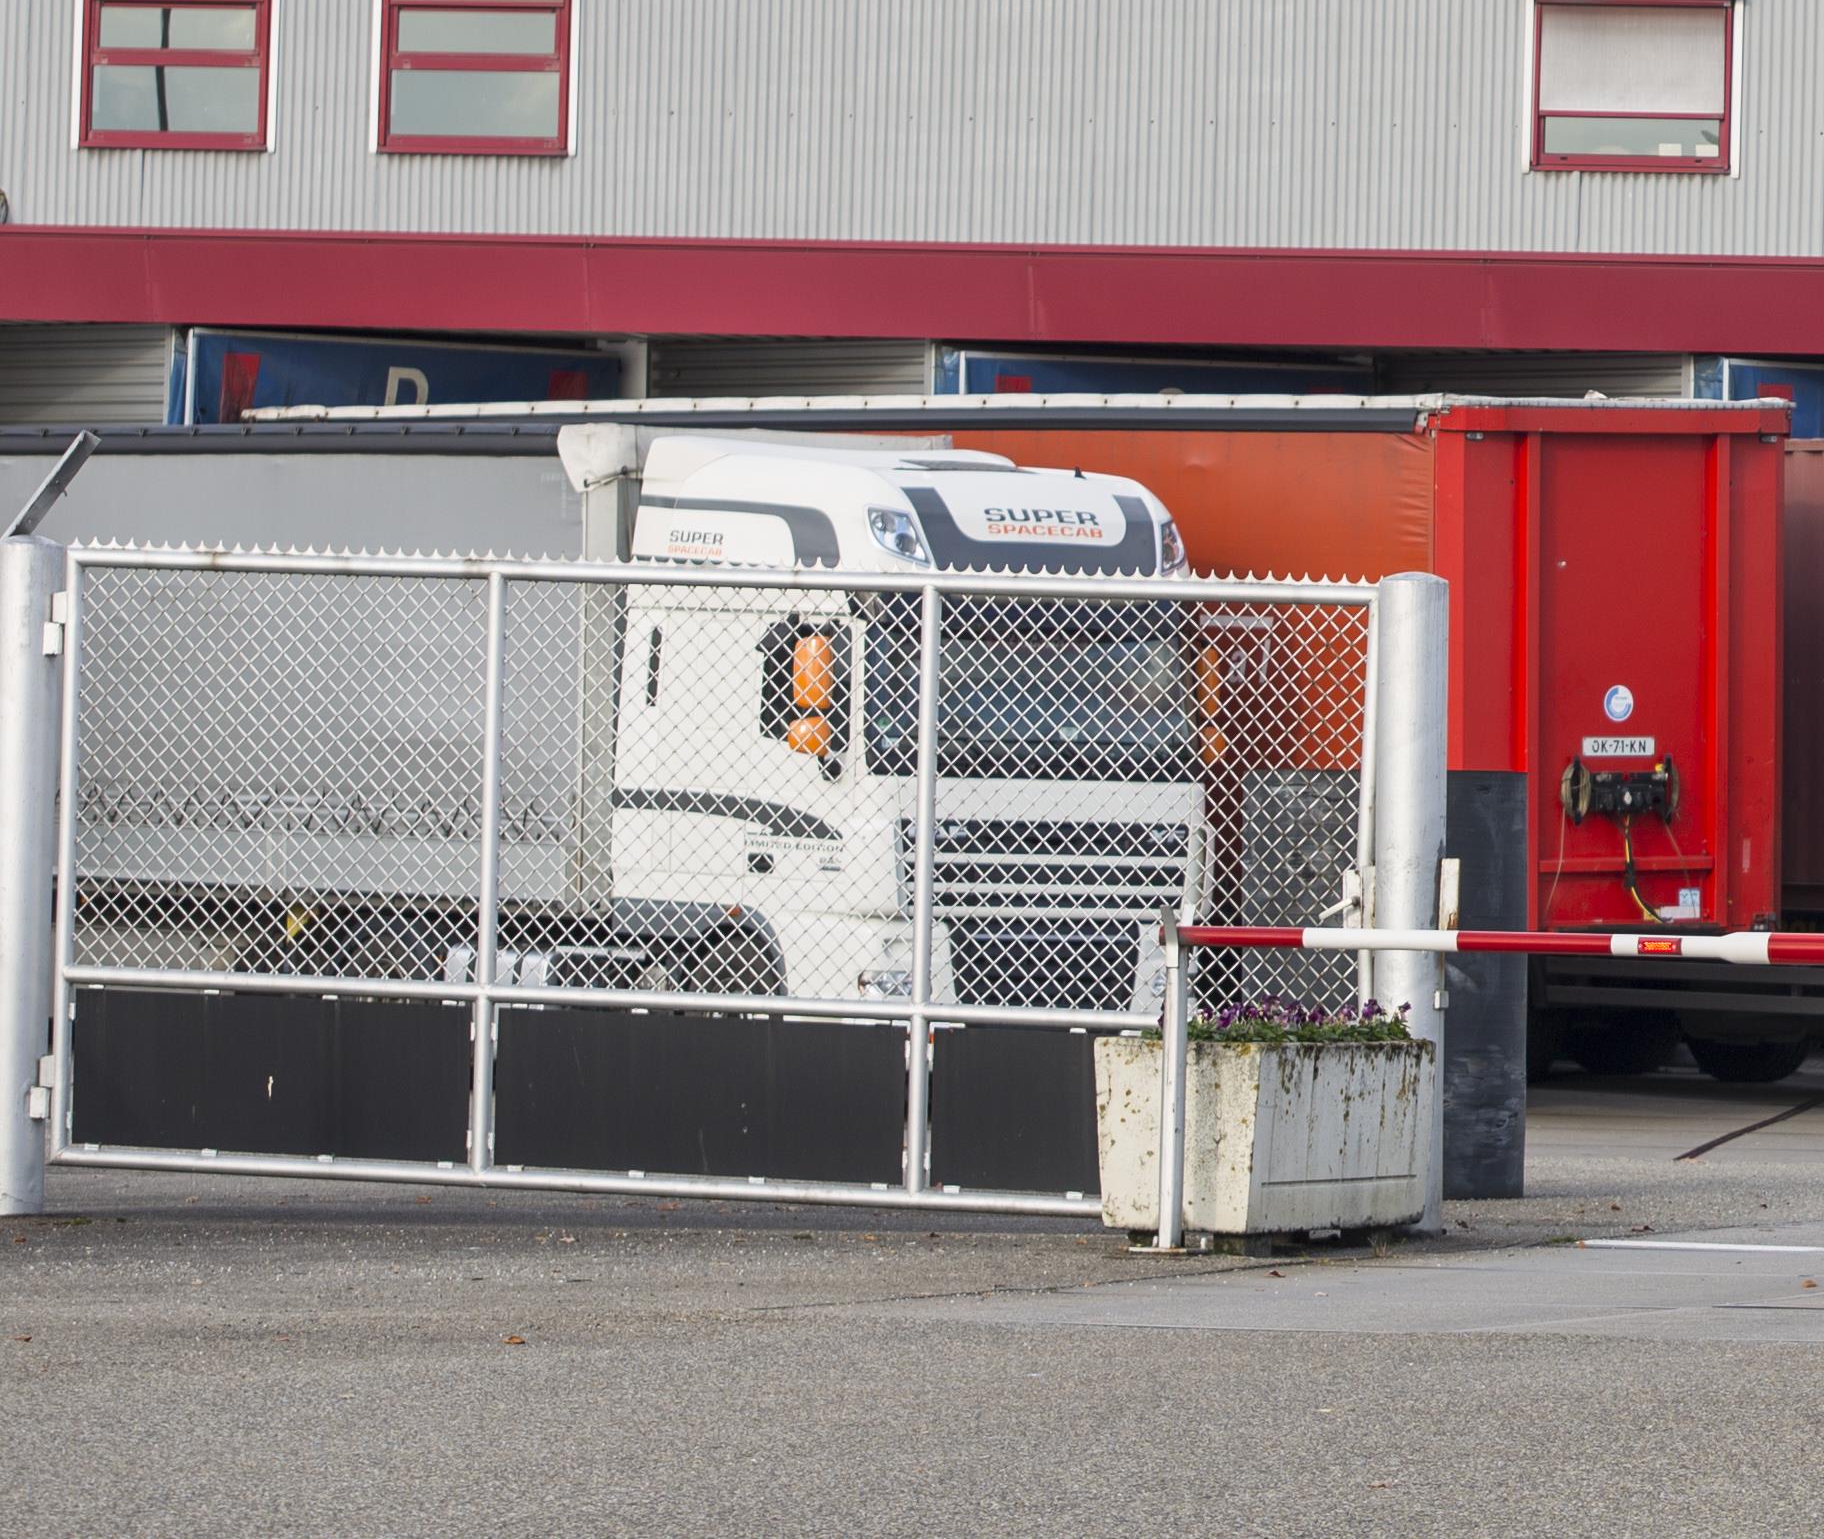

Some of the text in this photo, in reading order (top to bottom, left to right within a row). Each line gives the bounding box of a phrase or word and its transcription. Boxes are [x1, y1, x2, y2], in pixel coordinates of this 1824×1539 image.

[984, 508, 1099, 526] SUPER
[669, 530, 724, 545] SUPER
[987, 523, 1103, 539] SPACECAB
[1591, 740, 1647, 753] OK-71-KN
